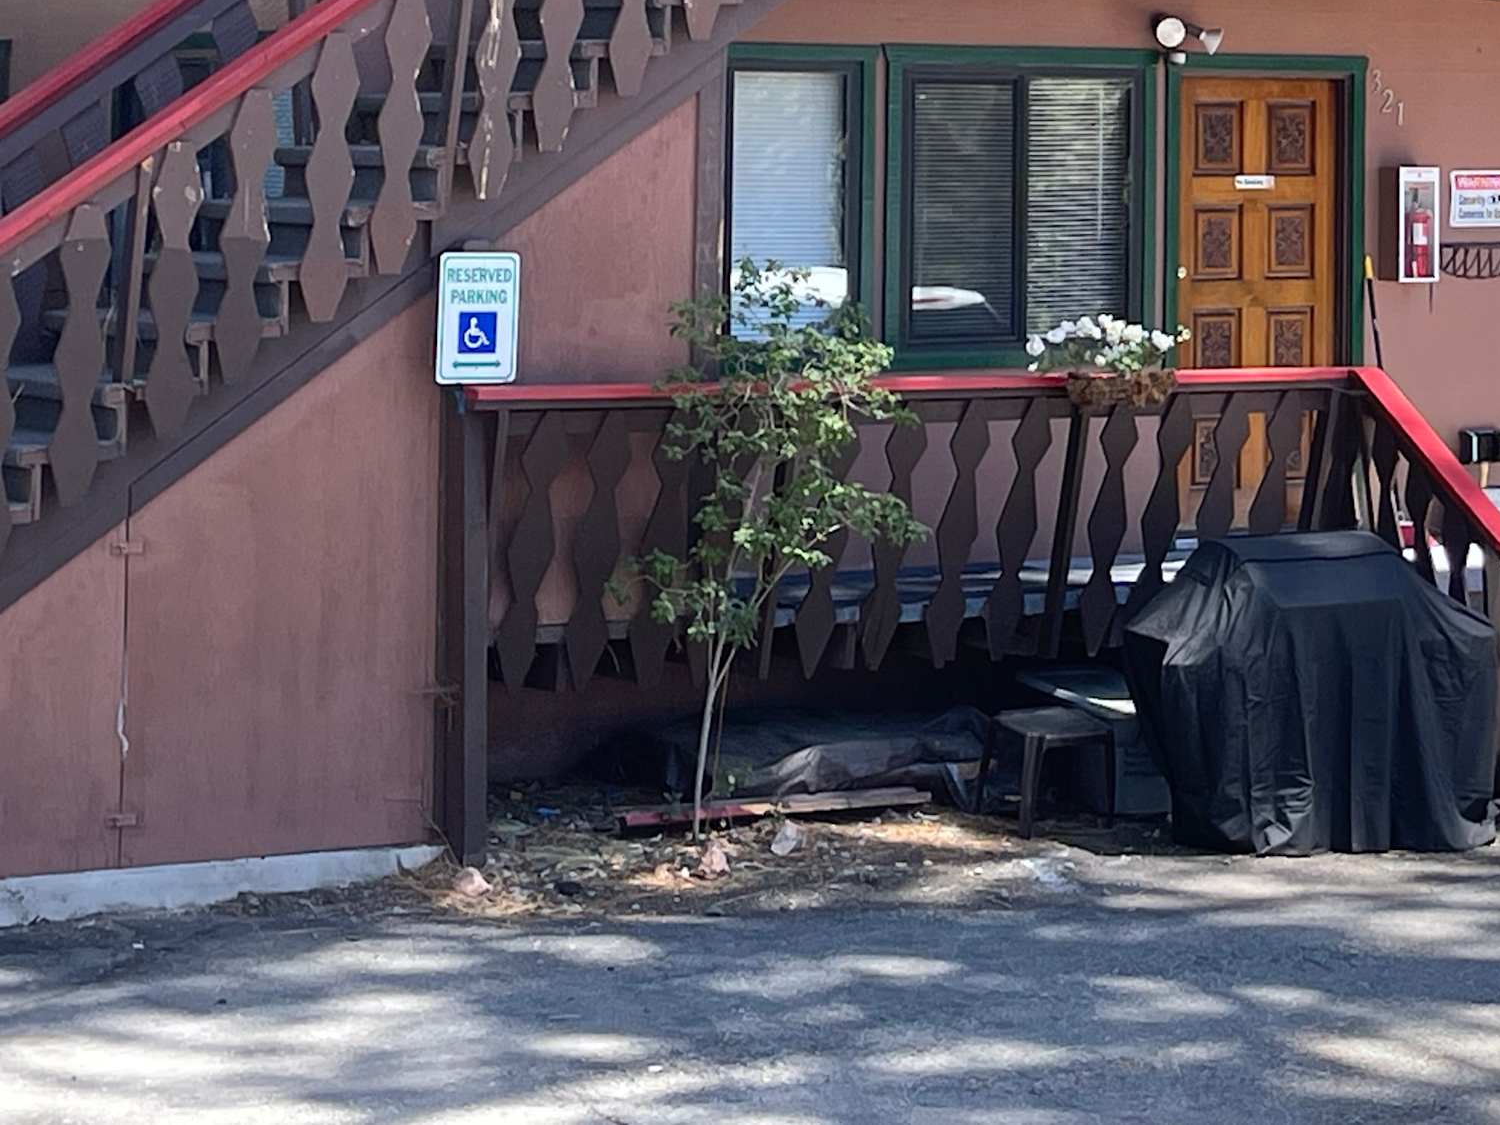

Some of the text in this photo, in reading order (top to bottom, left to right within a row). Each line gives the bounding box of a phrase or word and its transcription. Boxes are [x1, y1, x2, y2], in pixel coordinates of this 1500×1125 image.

[1372, 69, 1404, 126] 321
[447, 268, 513, 283] RESERVED
[450, 289, 508, 304] PARKING
